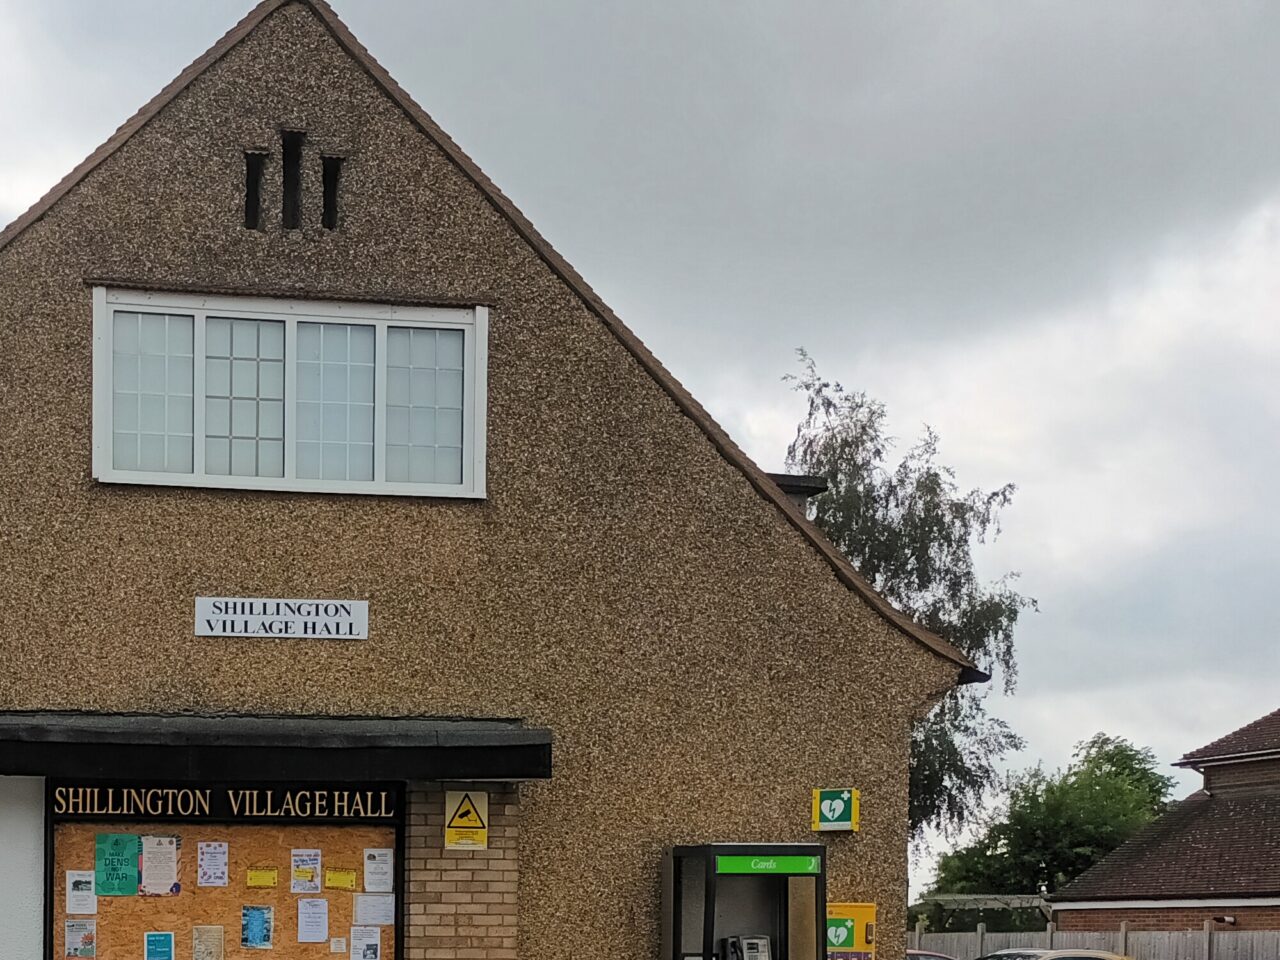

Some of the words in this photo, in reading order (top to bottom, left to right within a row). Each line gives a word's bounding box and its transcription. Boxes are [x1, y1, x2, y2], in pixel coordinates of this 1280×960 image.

[211, 600, 352, 617] SHILLINGTON
[205, 618, 296, 635] VILLAGE
[303, 620, 361, 636] HALL
[54, 787, 210, 815] SHILLINGTON
[228, 790, 328, 817] VILLAGE
[333, 791, 394, 817] HALL
[104, 858, 130, 867] DENS
[751, 858, 777, 869] Cards
[106, 873, 128, 881] WAR
